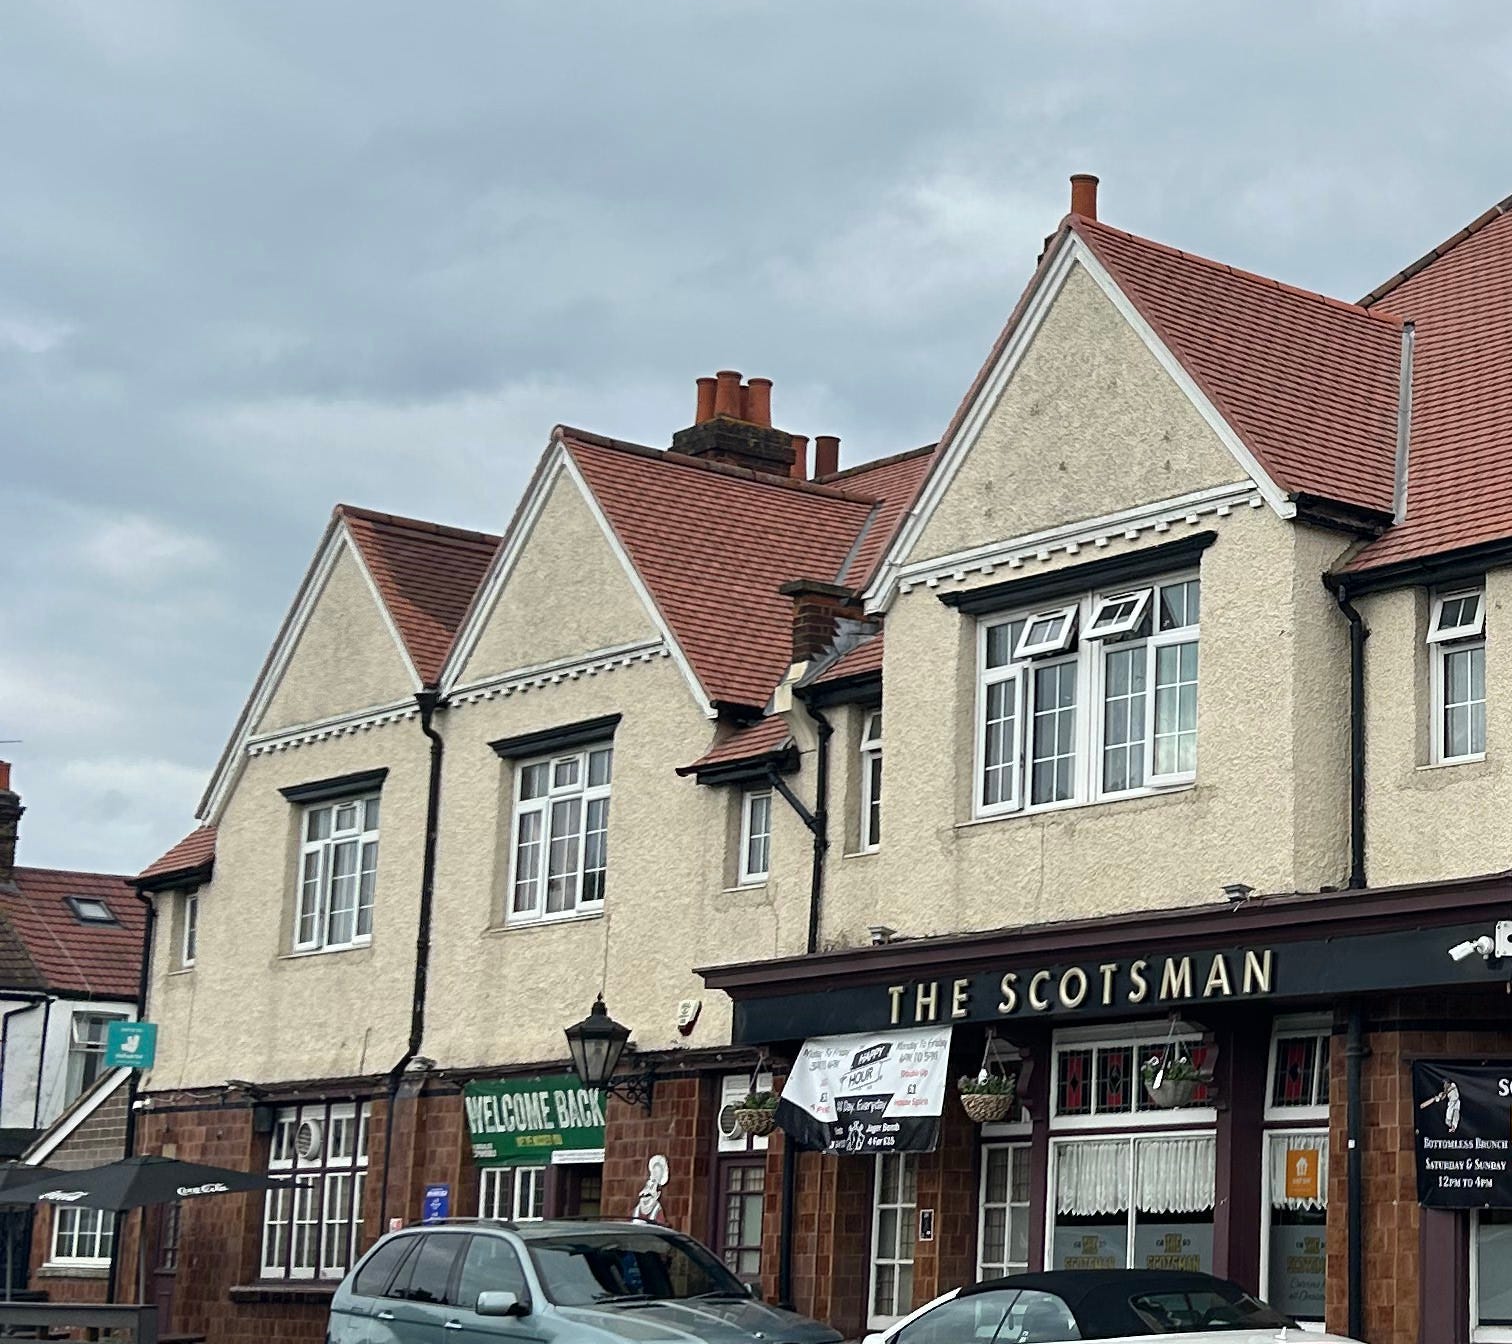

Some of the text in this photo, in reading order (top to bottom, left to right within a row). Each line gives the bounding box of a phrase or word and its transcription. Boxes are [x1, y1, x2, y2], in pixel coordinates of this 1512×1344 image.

[888, 949, 1273, 1025] THE SCOTSMAN
[848, 1067, 874, 1087] HOUR
[465, 1087, 606, 1134] WELCOME BACK
[1466, 1158, 1473, 1170] &
[1438, 1176, 1493, 1188] 12PM TO 4PM
